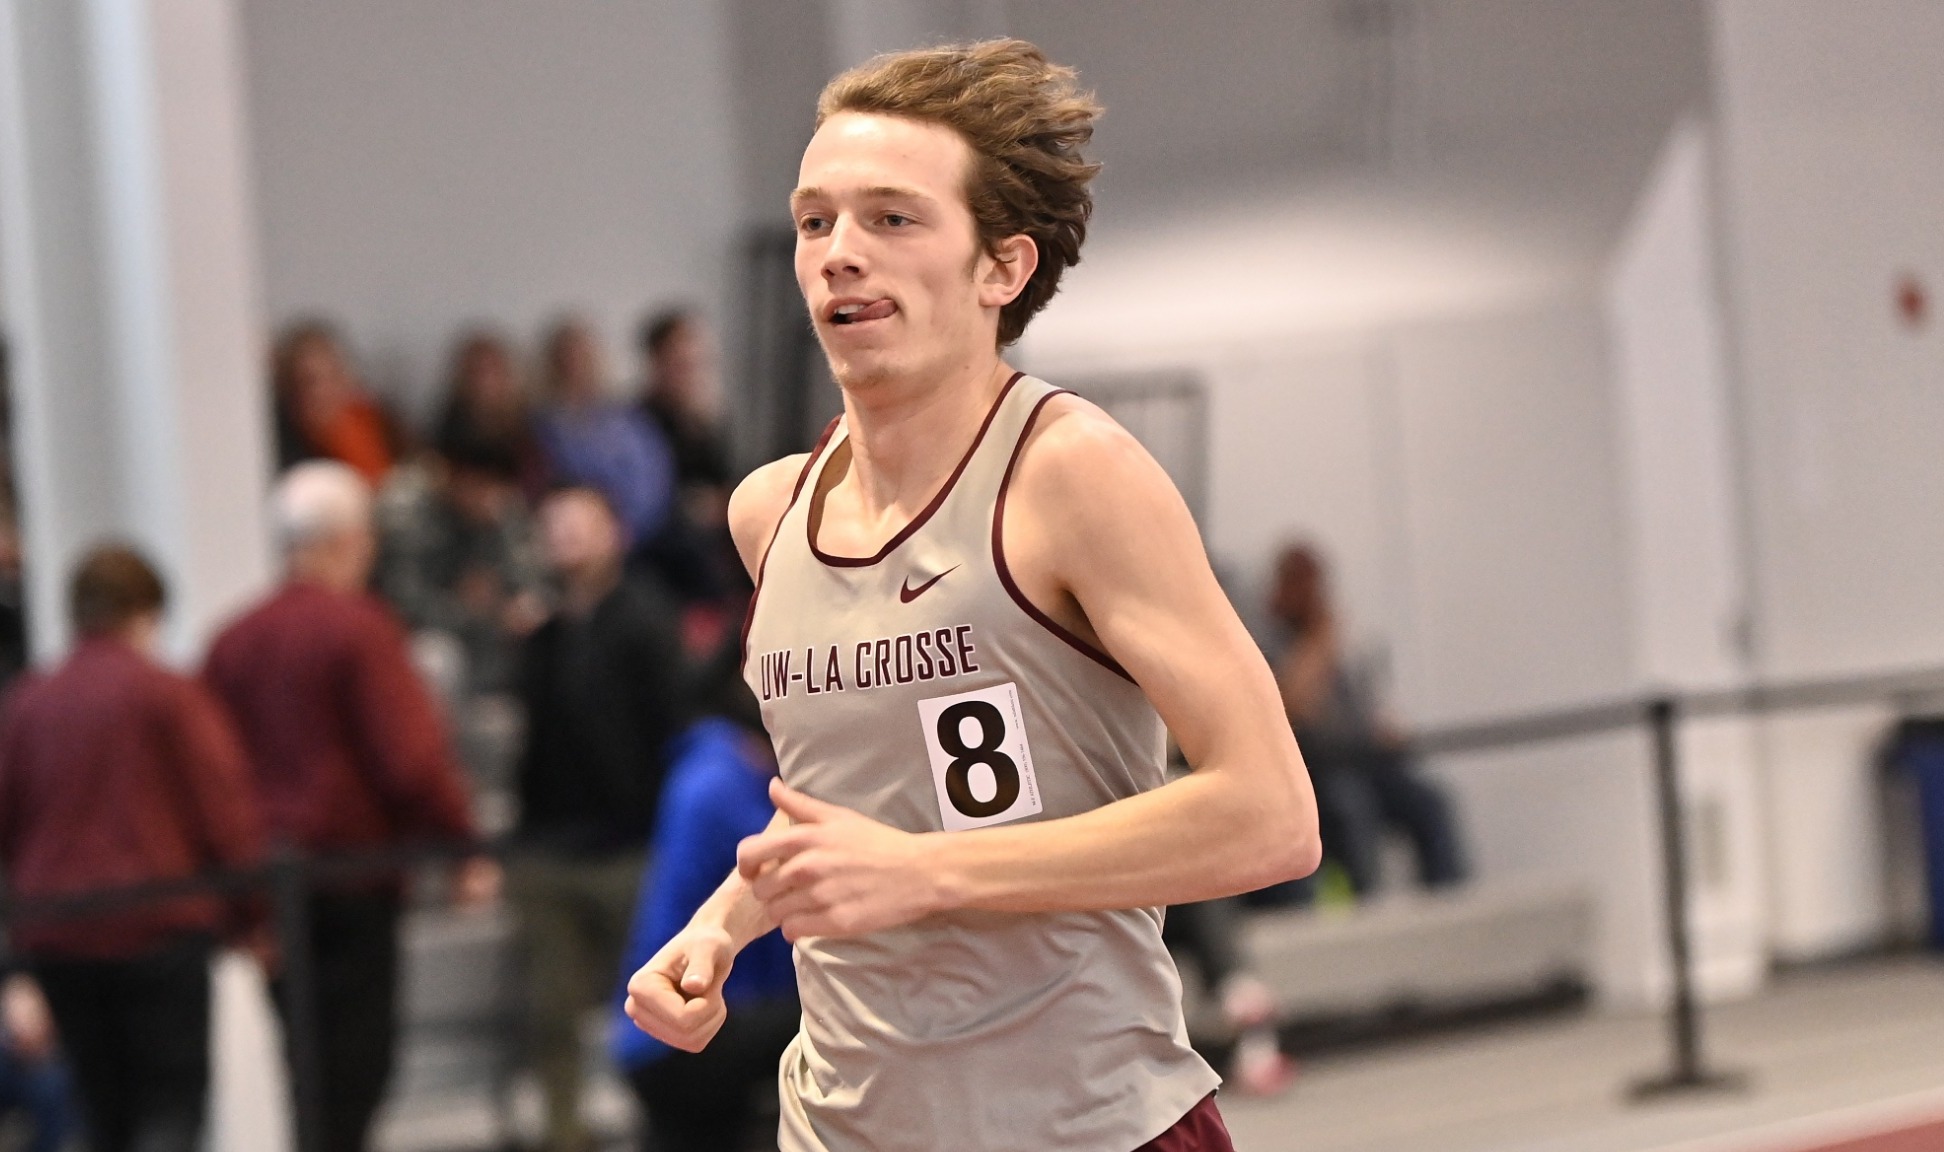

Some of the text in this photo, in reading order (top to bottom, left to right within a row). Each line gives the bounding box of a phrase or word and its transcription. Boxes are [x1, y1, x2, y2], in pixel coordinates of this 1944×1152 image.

[760, 624, 979, 701] UW-LA CROSSE
[937, 700, 1020, 818] 8
